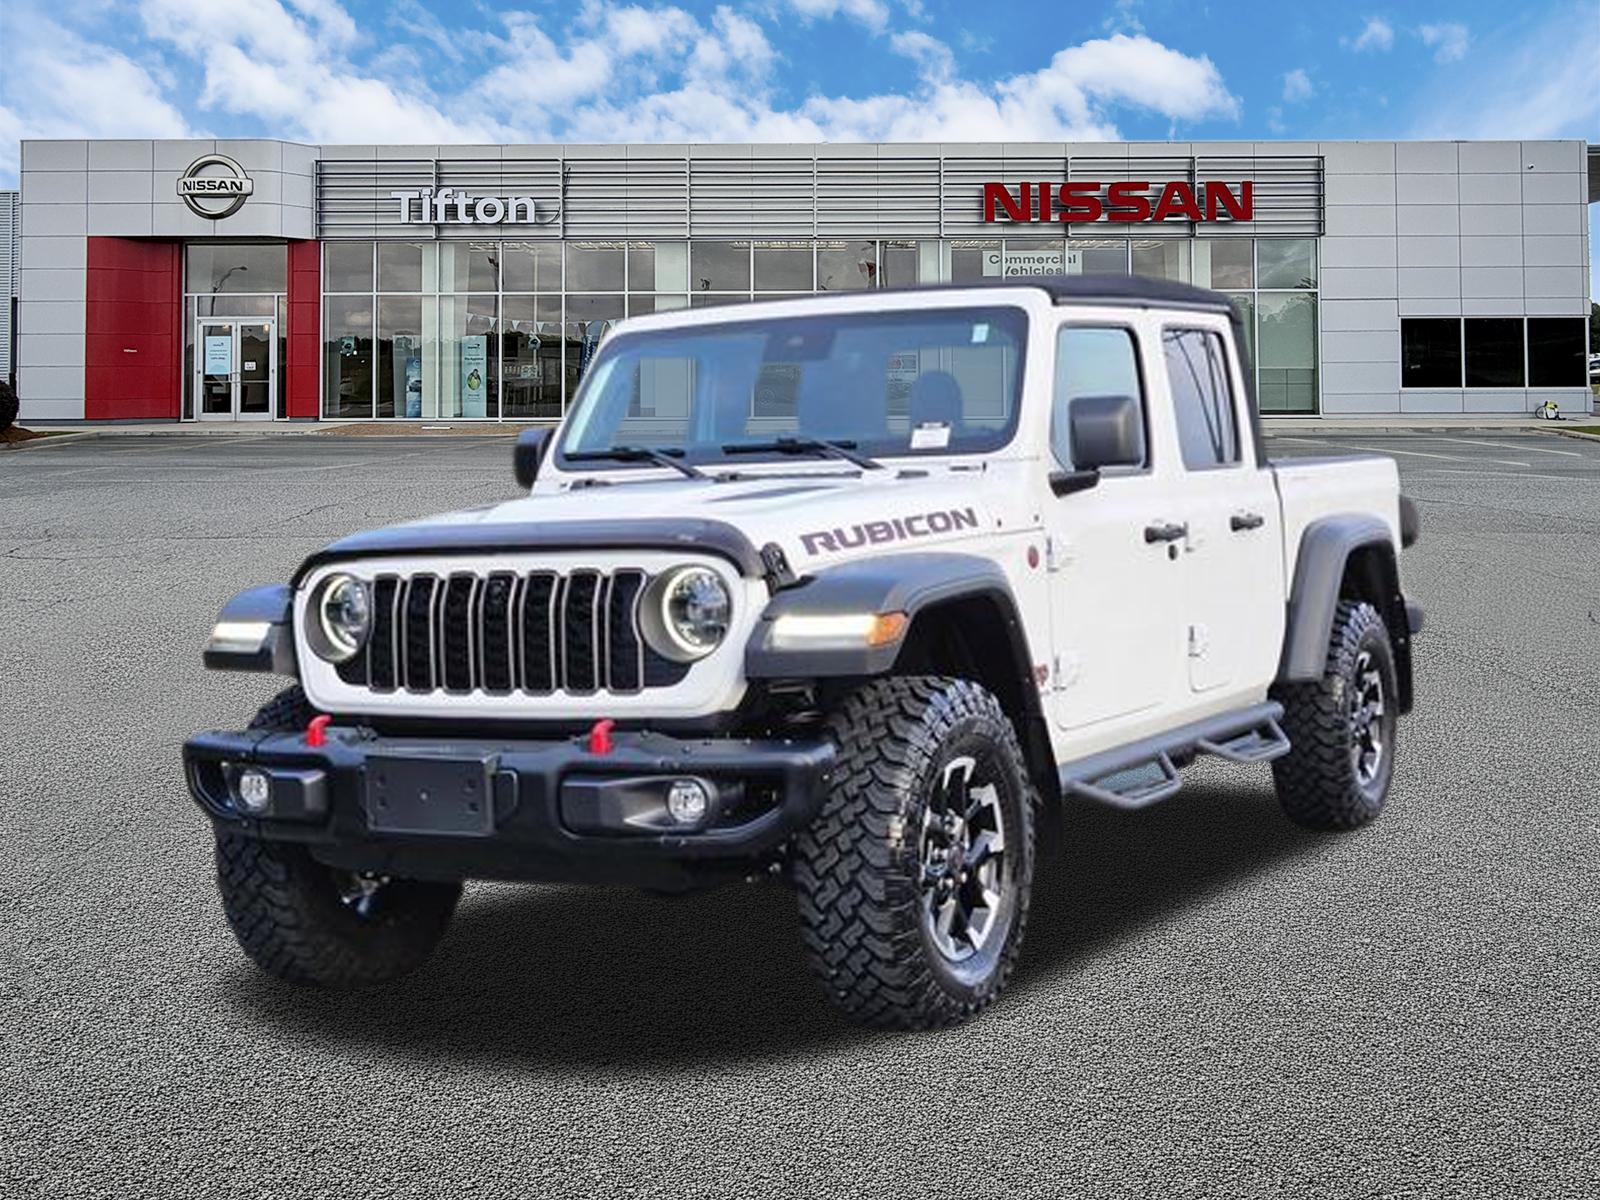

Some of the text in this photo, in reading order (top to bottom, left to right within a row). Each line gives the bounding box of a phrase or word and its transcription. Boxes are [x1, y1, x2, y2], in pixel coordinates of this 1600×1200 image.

[182, 180, 243, 191] NISSAN
[983, 181, 1254, 222] NISSAN
[391, 187, 536, 224] Tifton
[800, 507, 979, 556] RUBICON
